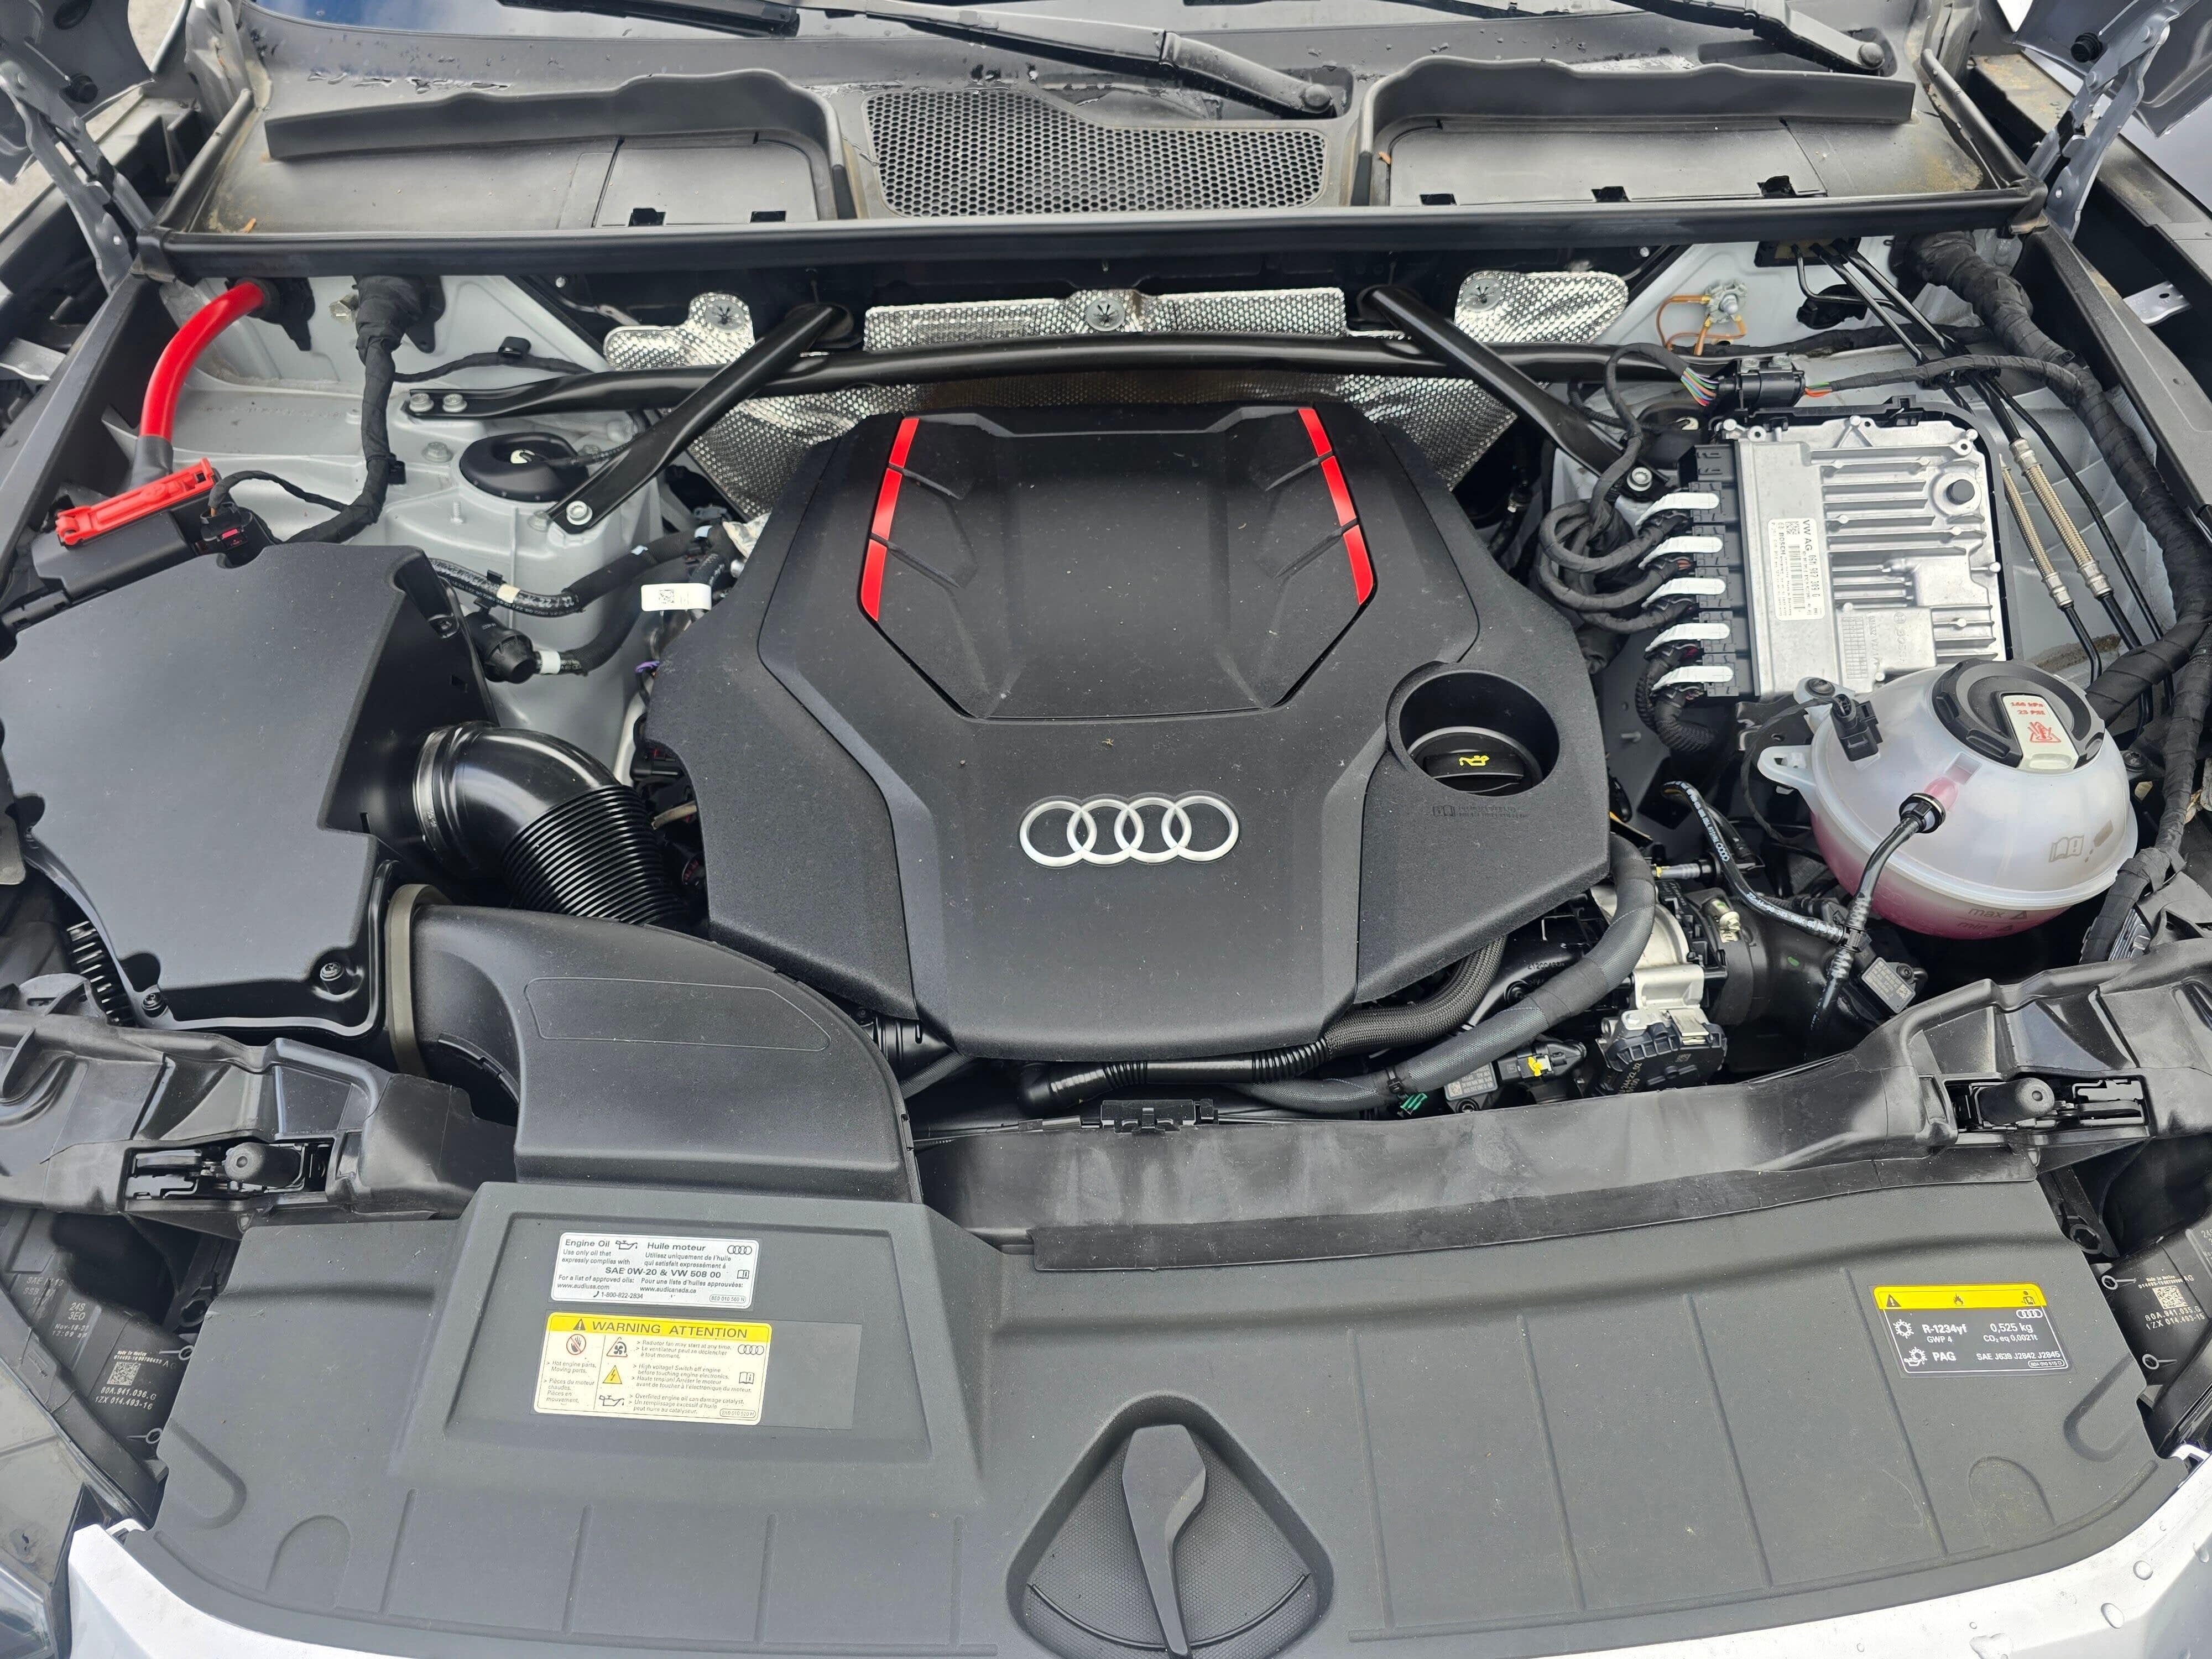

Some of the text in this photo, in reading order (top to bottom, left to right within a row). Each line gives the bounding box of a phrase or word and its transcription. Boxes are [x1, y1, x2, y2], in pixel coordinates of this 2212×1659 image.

[1803, 519, 1811, 535] VW
[1804, 538, 1813, 551] AG
[1968, 908, 2006, 919] max
[1957, 922, 1989, 930] min
[565, 1239, 595, 1248] Engine
[667, 1253, 703, 1261] uniquement
[627, 1267, 657, 1276] 0W-20
[69, 1302, 86, 1312] 24S
[2145, 1305, 2201, 1321] 80A.941.035.G
[2146, 1312, 2205, 1331] 1ZX 014.493-15
[592, 1321, 748, 1339] WARNING ATTENTION
[1922, 1322, 2033, 1335] R-1234yf 0,525 kg
[2010, 1333, 2038, 1342] 0,0021t
[1932, 1351, 1957, 1361] PAG
[1976, 1353, 1992, 1361] SAE
[101, 1386, 157, 1400] 80A.941.036.G
[110, 1397, 153, 1410] 014.493-16
